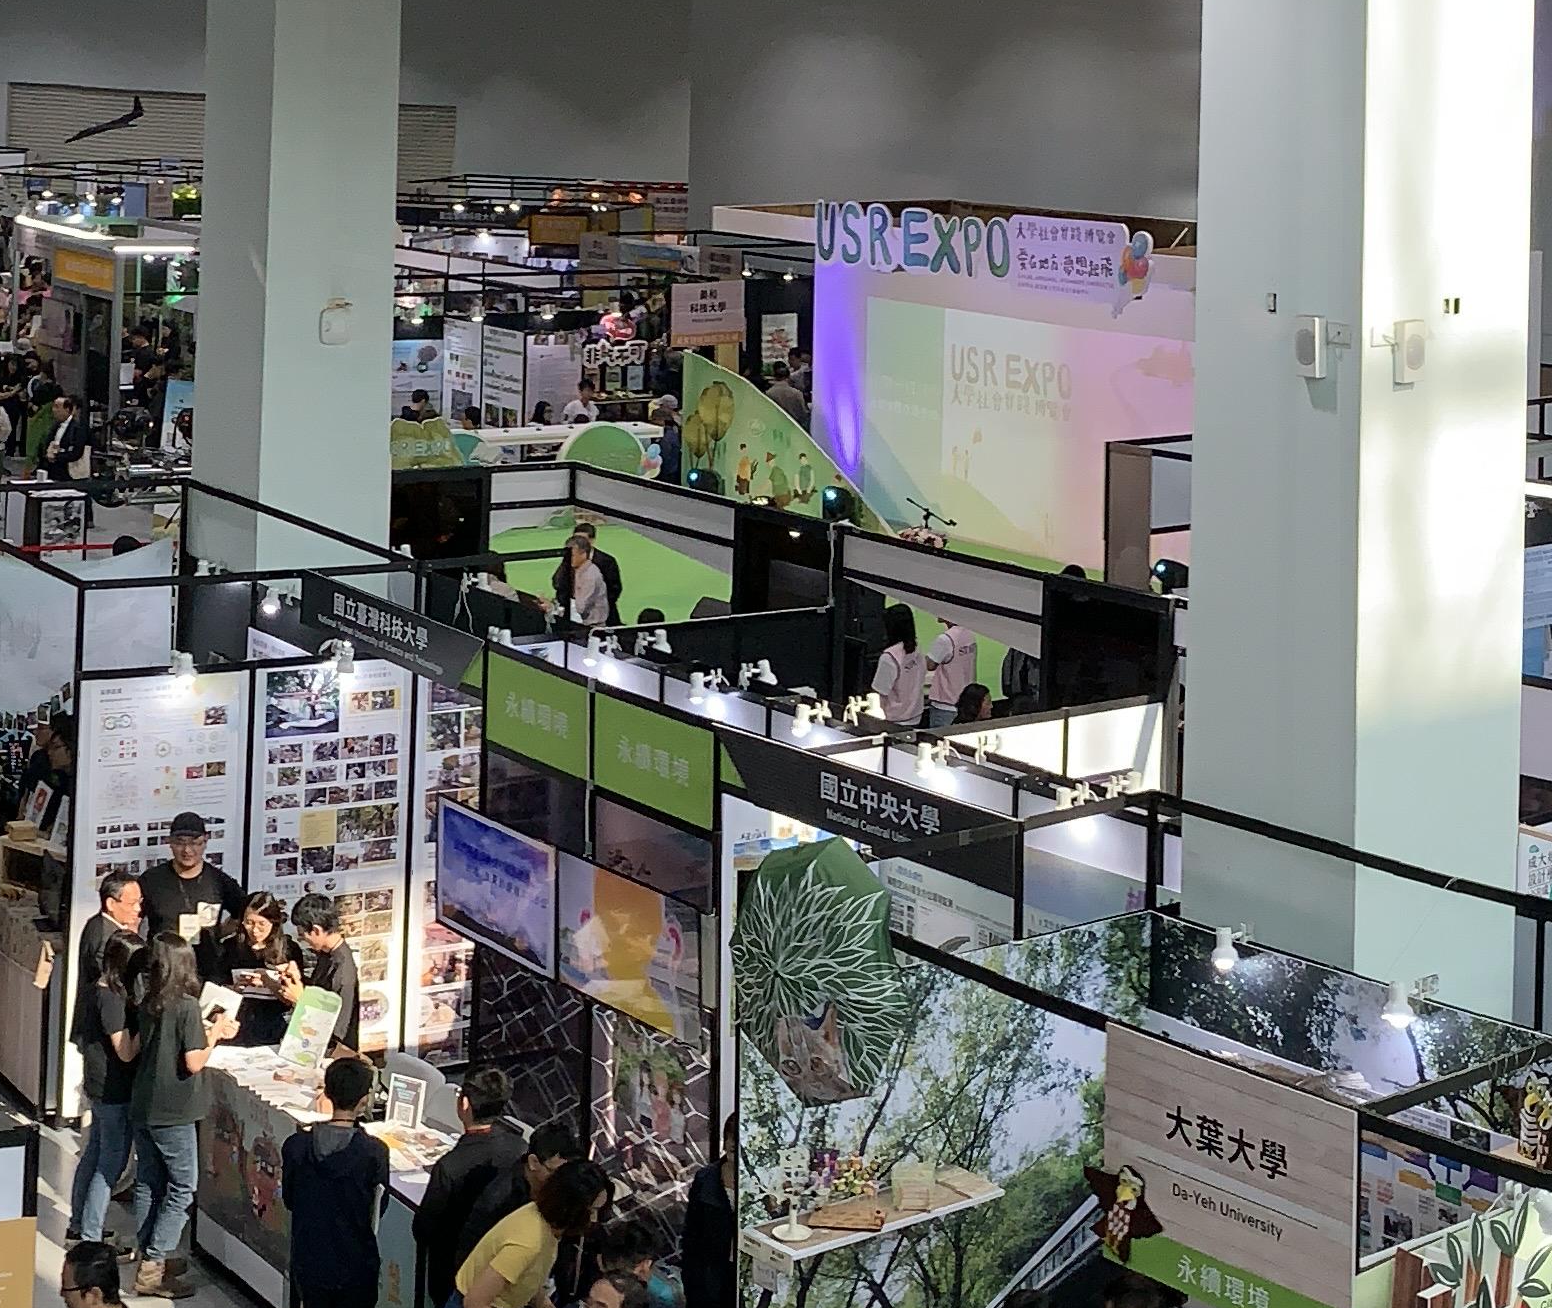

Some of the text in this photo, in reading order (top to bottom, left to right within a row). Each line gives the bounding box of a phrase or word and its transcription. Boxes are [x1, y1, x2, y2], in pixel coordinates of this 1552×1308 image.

[815, 200, 1011, 278] USR EXPO
[950, 344, 1072, 401] USR EXPO
[333, 592, 428, 651] 國立臺灣科技大學
[819, 770, 941, 836] 國立中央大學
[1165, 1105, 1288, 1180] 大葉大學
[1171, 1182, 1284, 1242] Da-Yeh University
